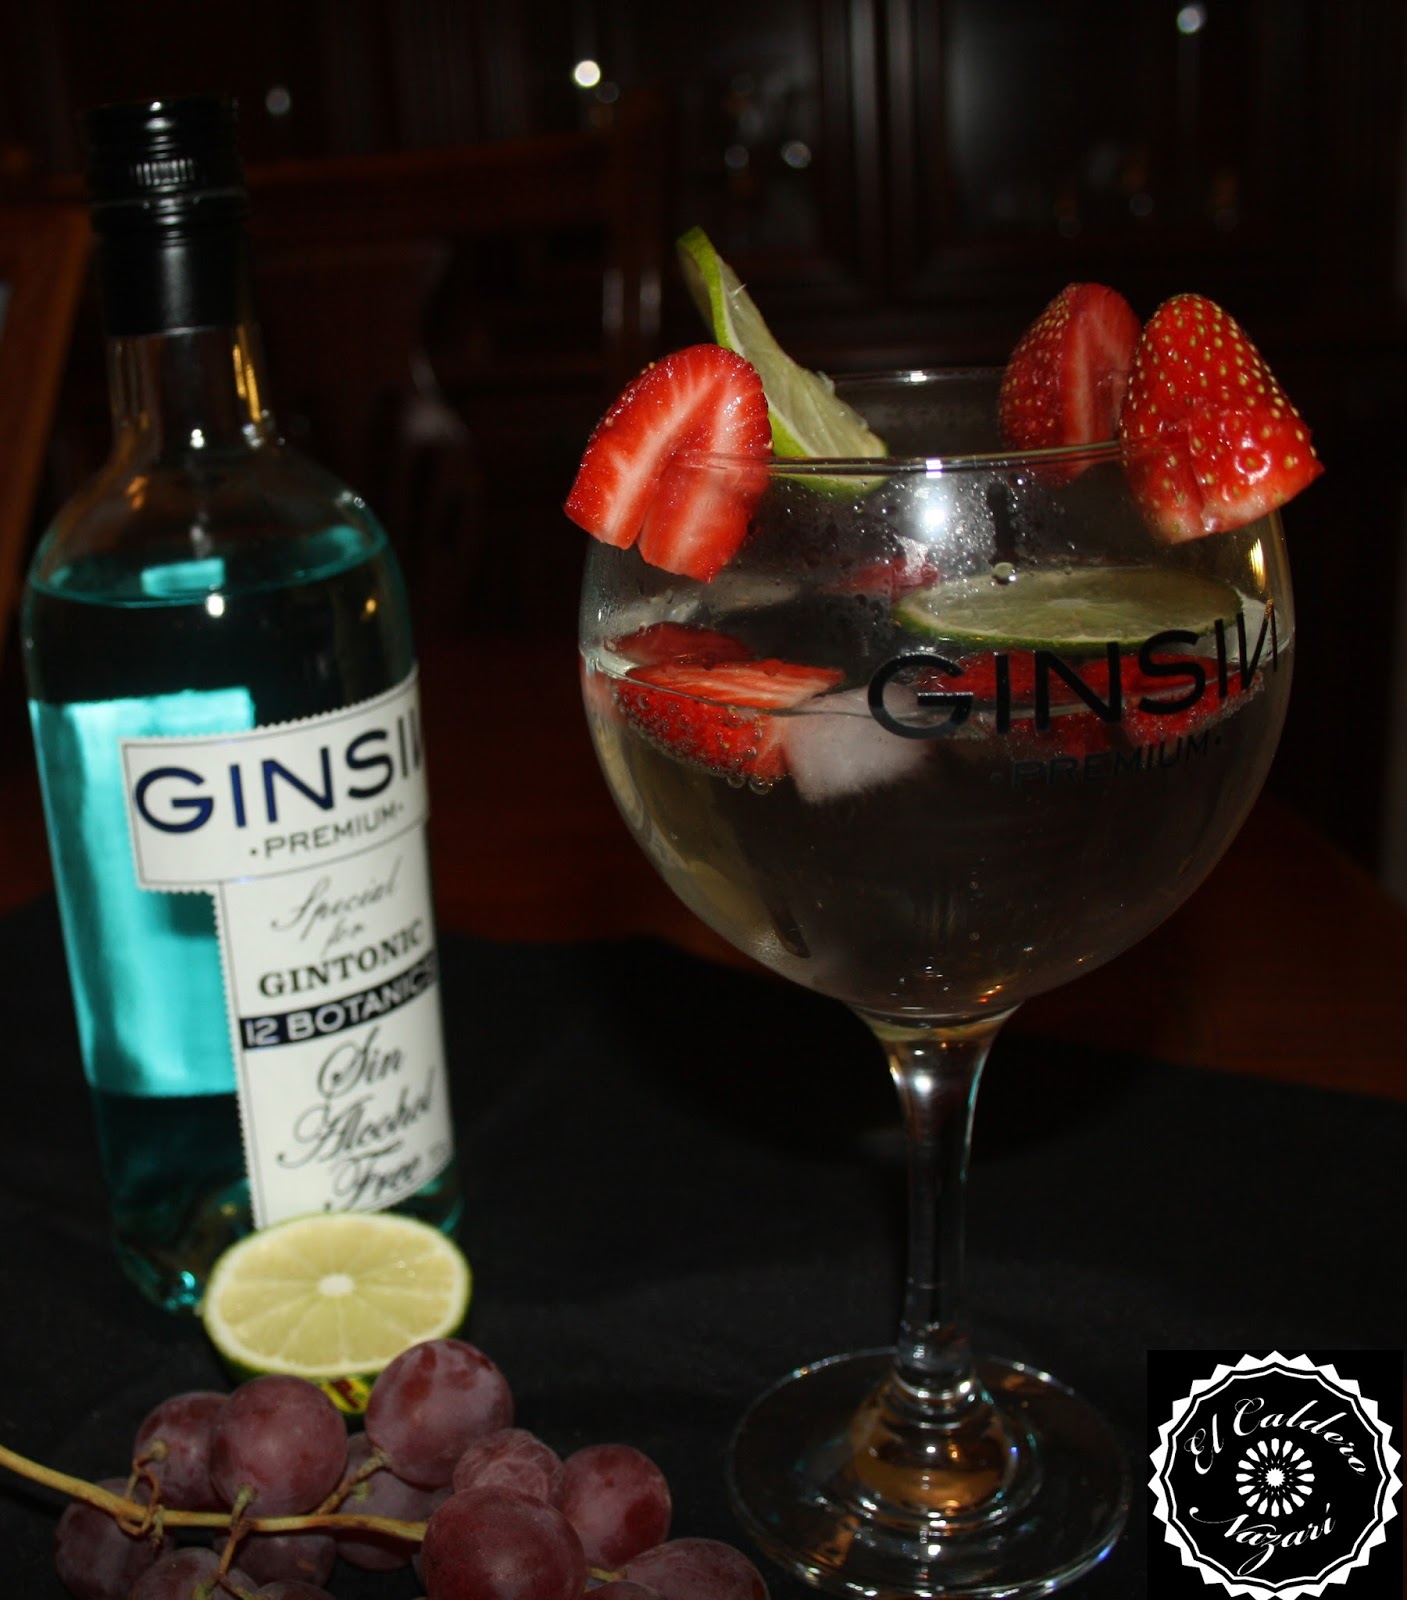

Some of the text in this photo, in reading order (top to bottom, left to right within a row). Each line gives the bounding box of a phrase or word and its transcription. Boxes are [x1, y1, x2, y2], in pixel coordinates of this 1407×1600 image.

[868, 600, 1278, 740] GINSIN
[1010, 729, 1210, 790] PREMIUM
[263, 805, 398, 858] PREMIUM
[270, 856, 403, 941] Special
[259, 917, 423, 999] GINTONIC
[245, 1018, 281, 1047] 12
[317, 1024, 404, 1099] Sin
[276, 1065, 436, 1169] Alcohol
[323, 1139, 420, 1211] Free
